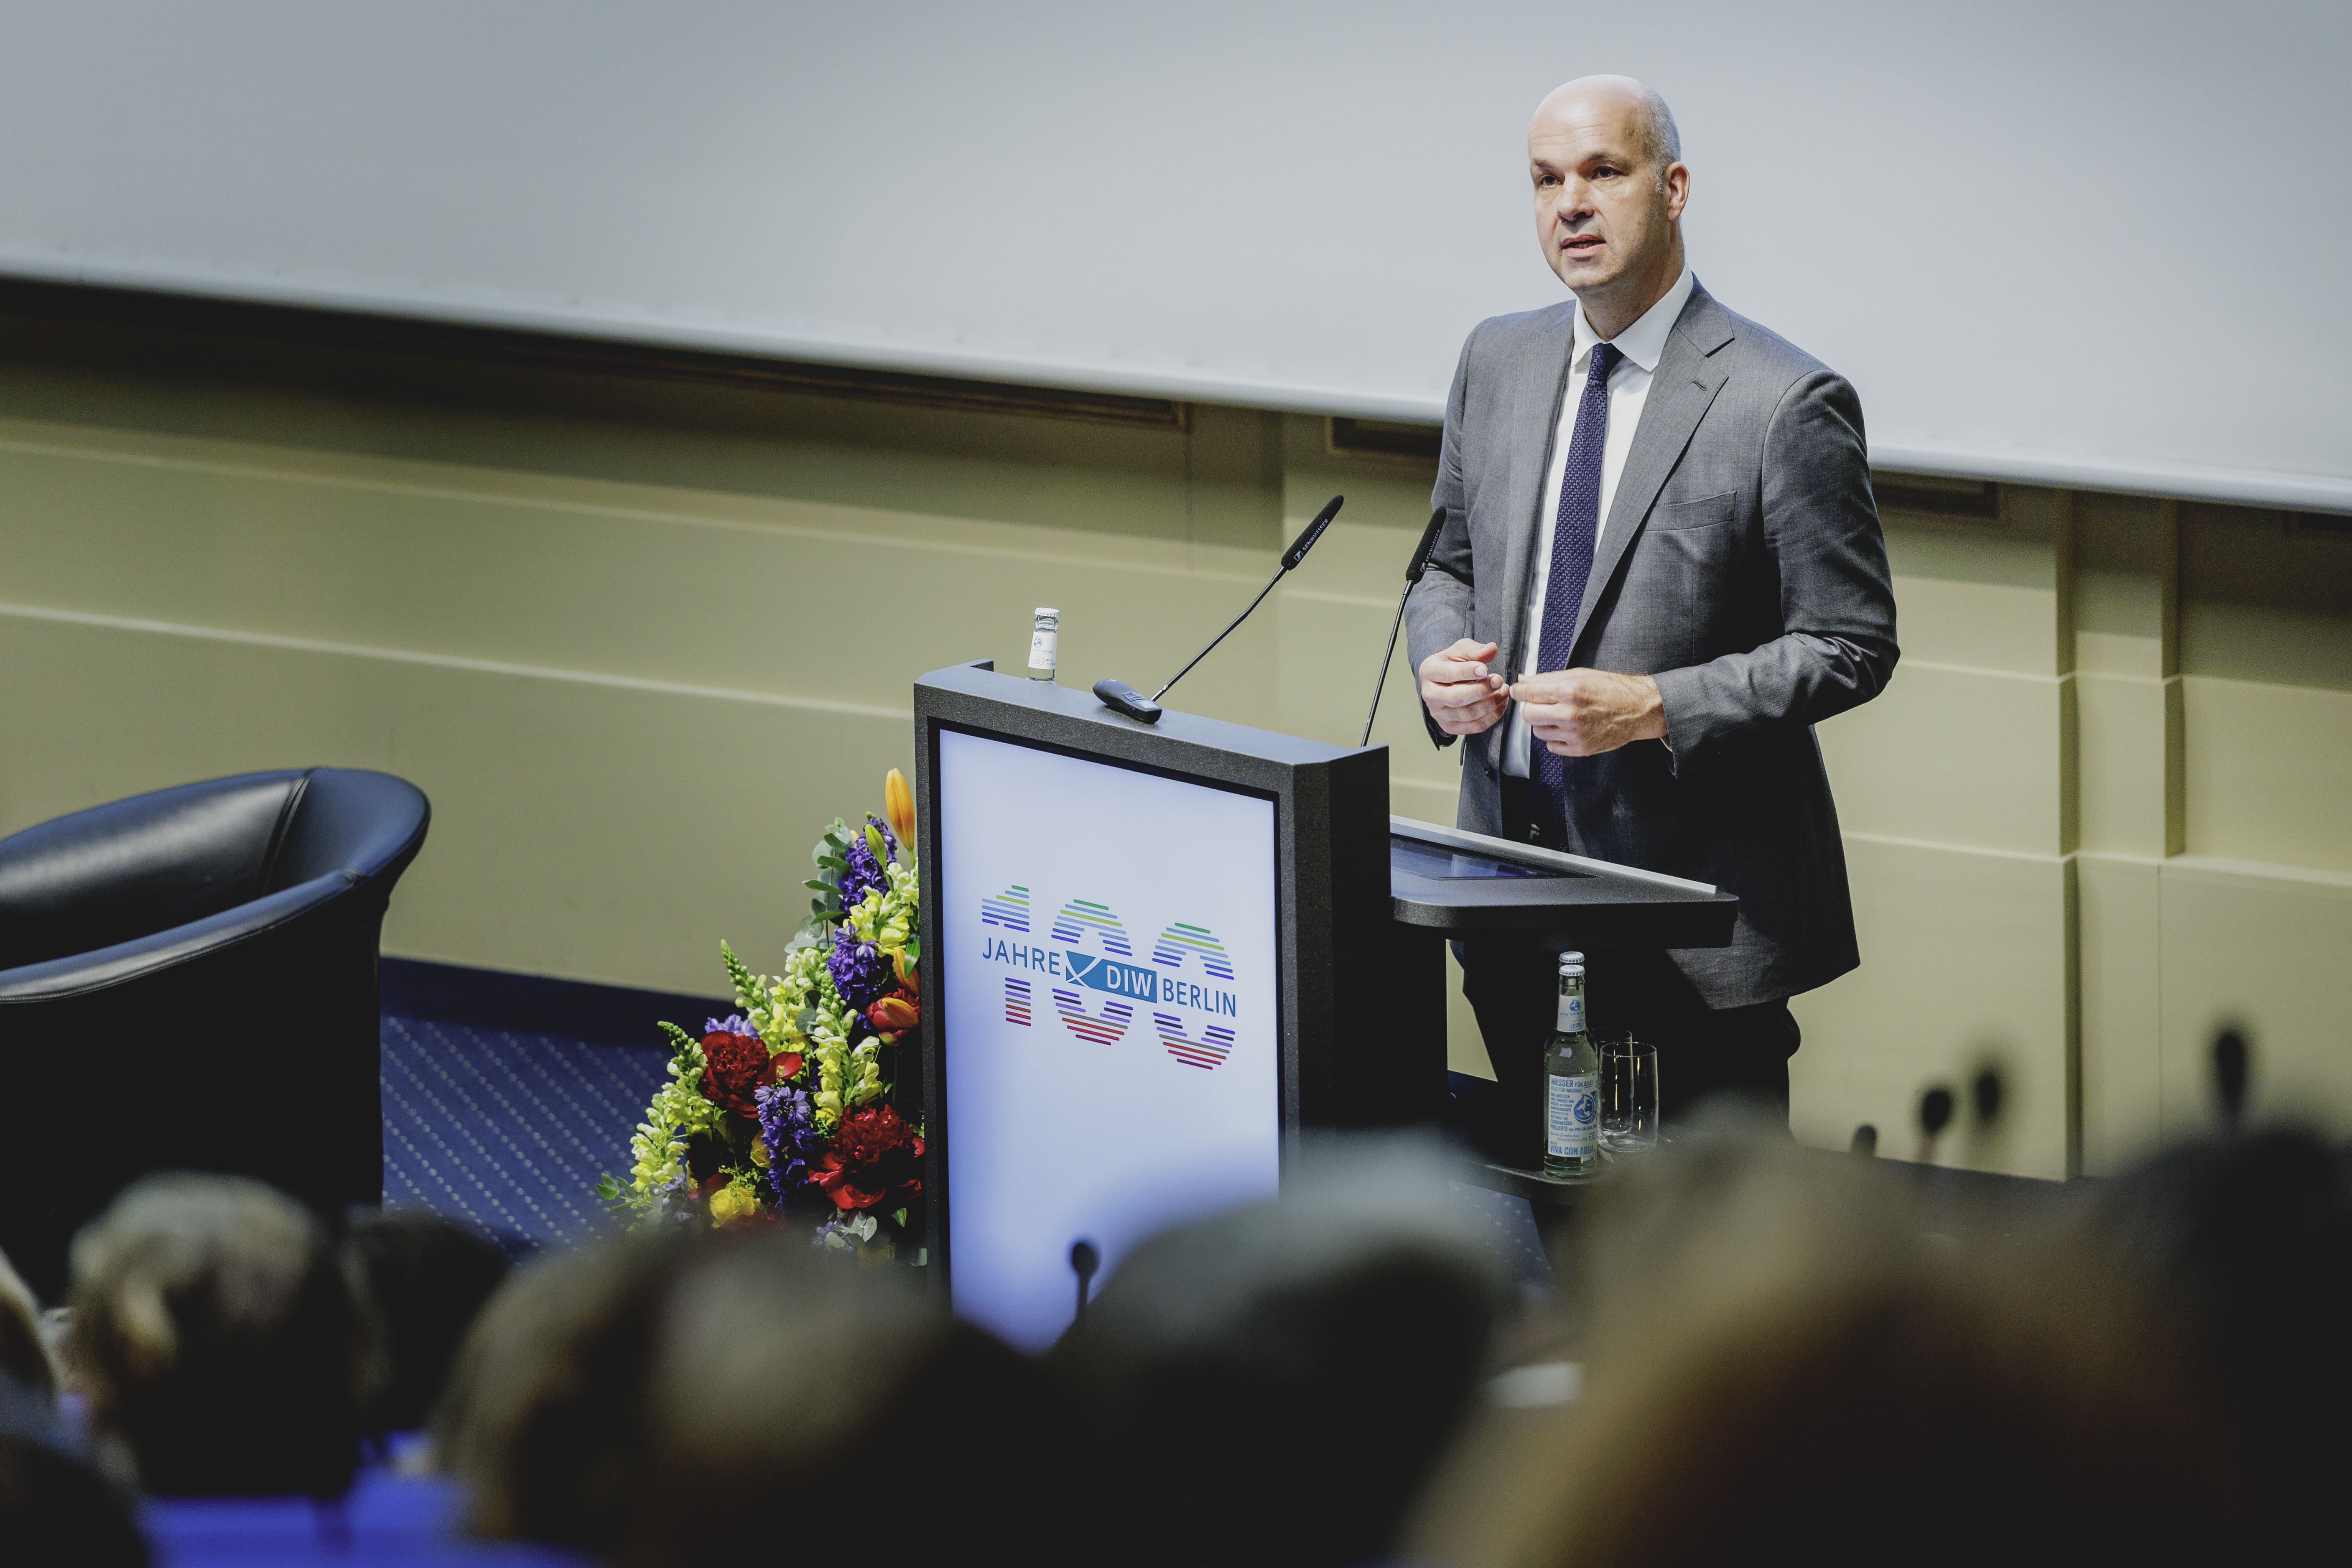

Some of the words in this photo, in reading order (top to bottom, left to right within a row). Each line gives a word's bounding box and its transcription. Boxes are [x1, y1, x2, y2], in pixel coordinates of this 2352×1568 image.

[1302, 518, 1329, 551] SENNHEISER
[982, 937, 1061, 976] JAHRE
[1106, 964, 1152, 997] DIW
[1163, 978, 1236, 1017] BERLIN
[1550, 1145, 1562, 1154] VIVA
[1564, 1147, 1578, 1155] CON
